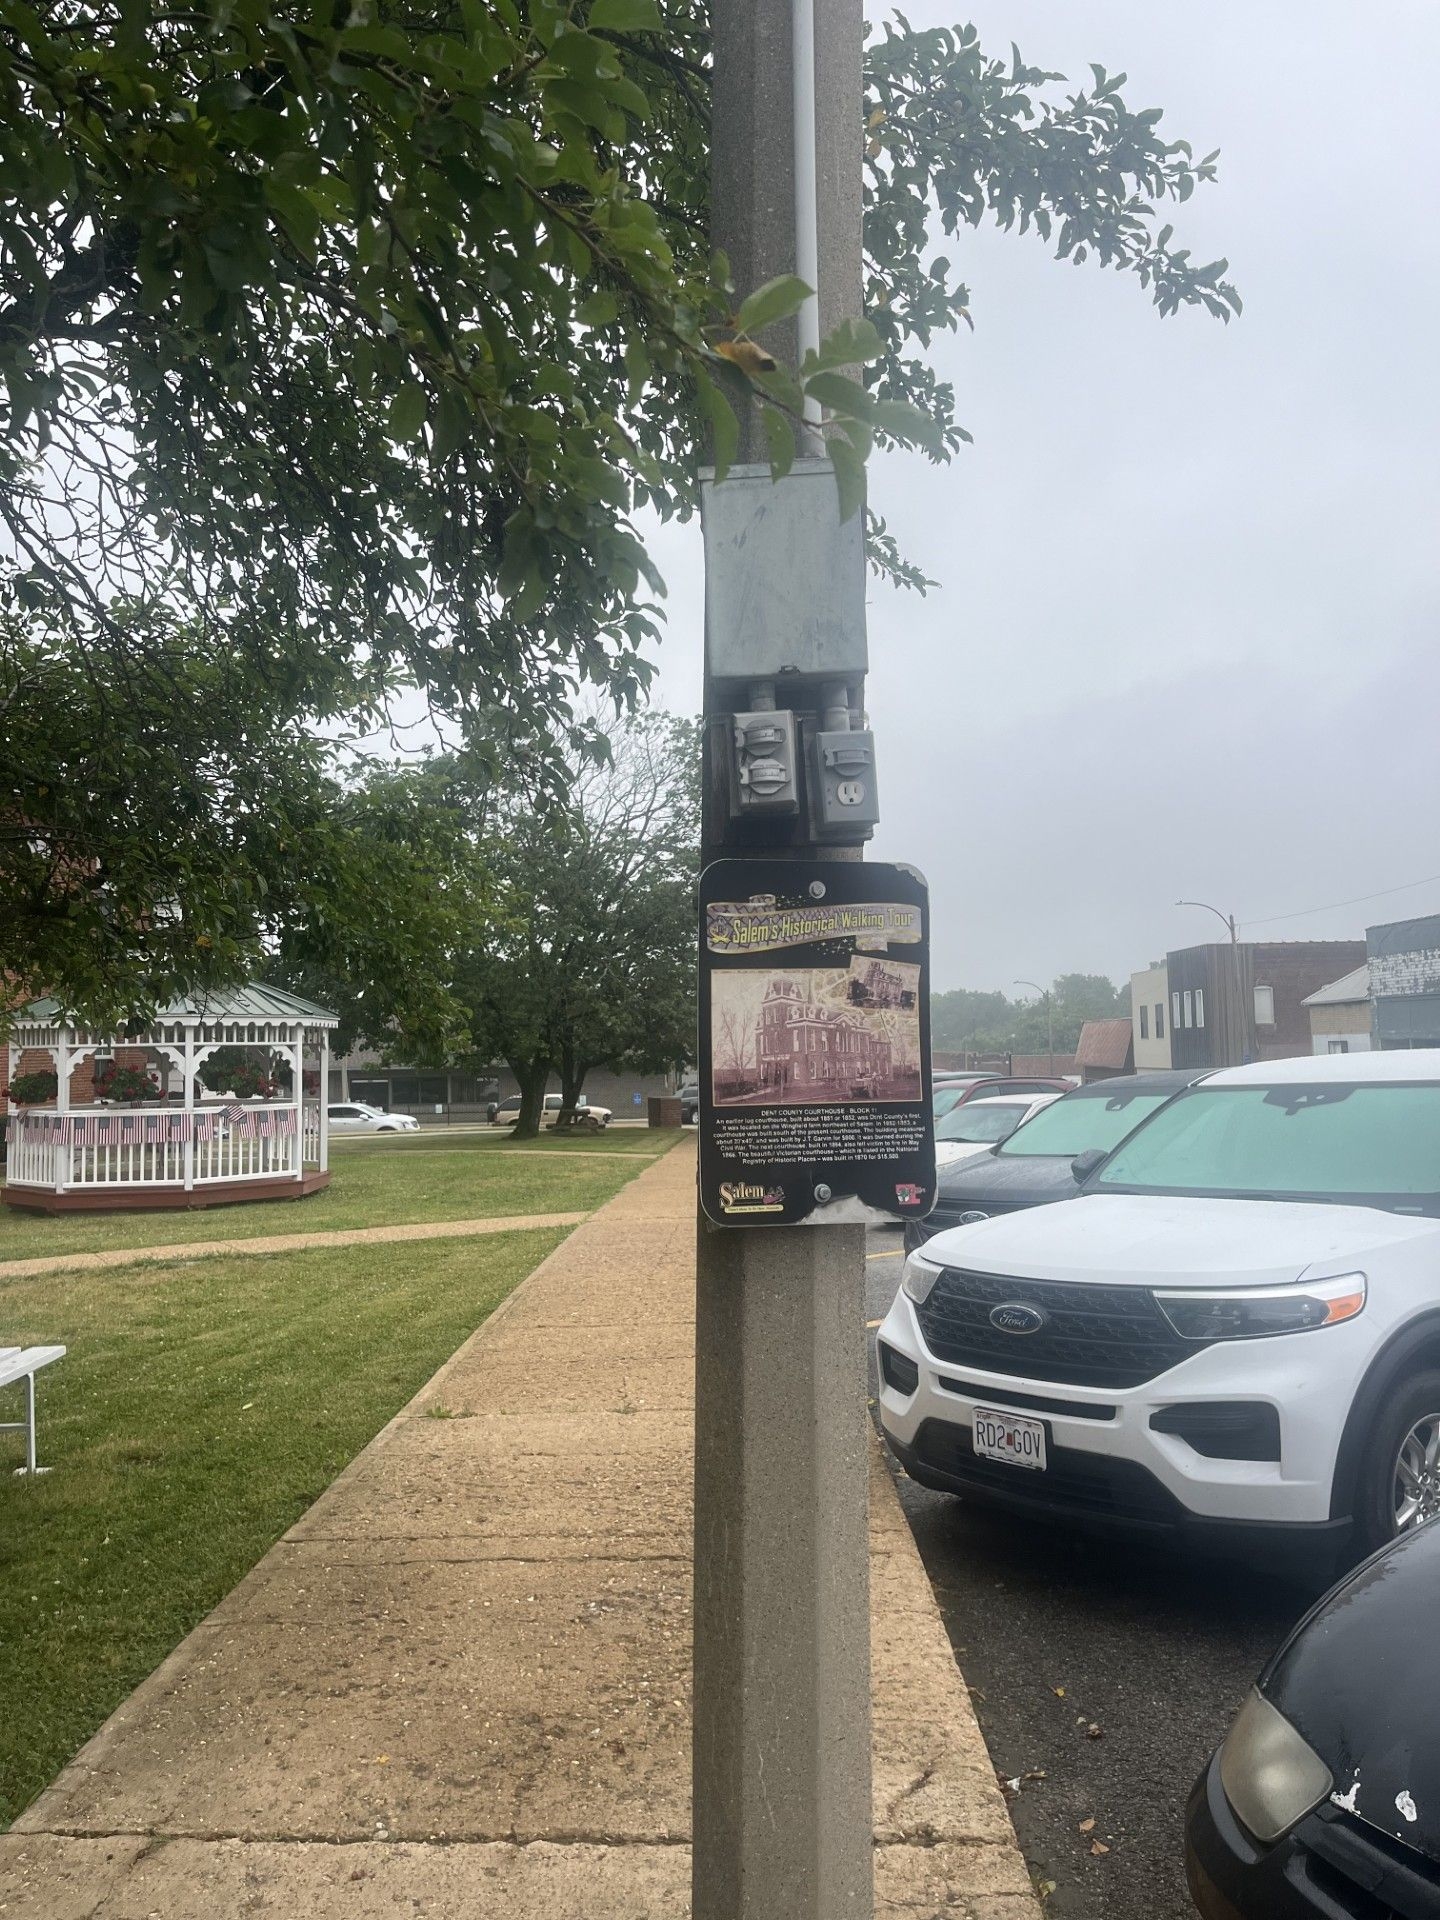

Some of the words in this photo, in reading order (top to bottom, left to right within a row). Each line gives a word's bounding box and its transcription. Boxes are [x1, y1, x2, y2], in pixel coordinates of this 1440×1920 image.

[733, 918, 778, 944] Salem's
[782, 914, 837, 937] Historical
[842, 911, 884, 928] Walking
[888, 908, 913, 926] Tour
[719, 1182, 765, 1208] Salem
[1000, 1310, 1028, 1328] Ford
[976, 1421, 1005, 1450] RD2
[1013, 1429, 1040, 1458] GOV
